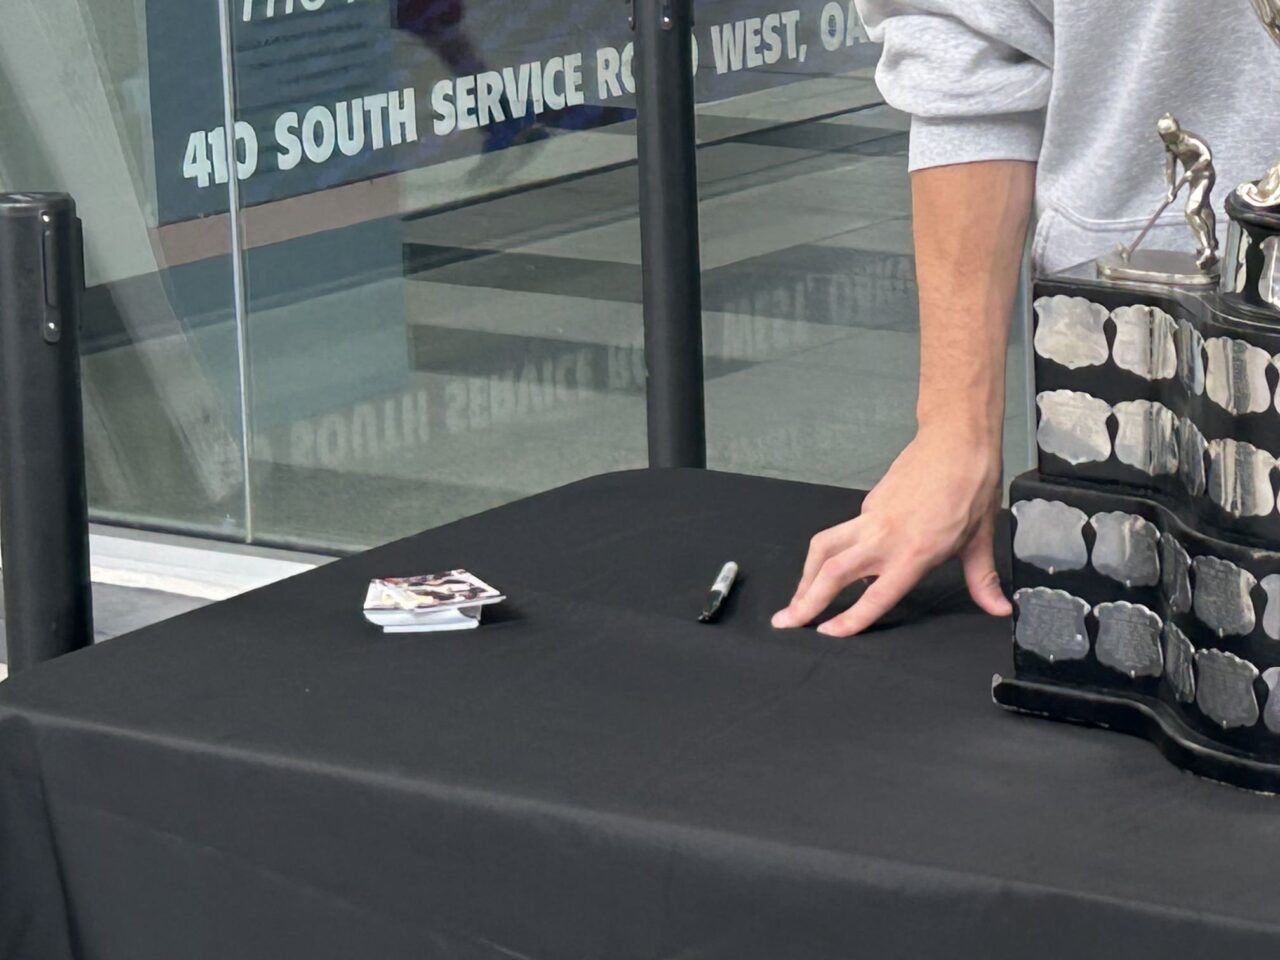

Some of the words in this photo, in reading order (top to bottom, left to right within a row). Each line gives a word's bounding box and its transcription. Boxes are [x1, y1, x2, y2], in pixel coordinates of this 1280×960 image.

[182, 120, 258, 188] 410
[274, 87, 418, 171] SOUTH
[431, 51, 585, 137] SERVICE
[710, 9, 808, 75] WEST,
